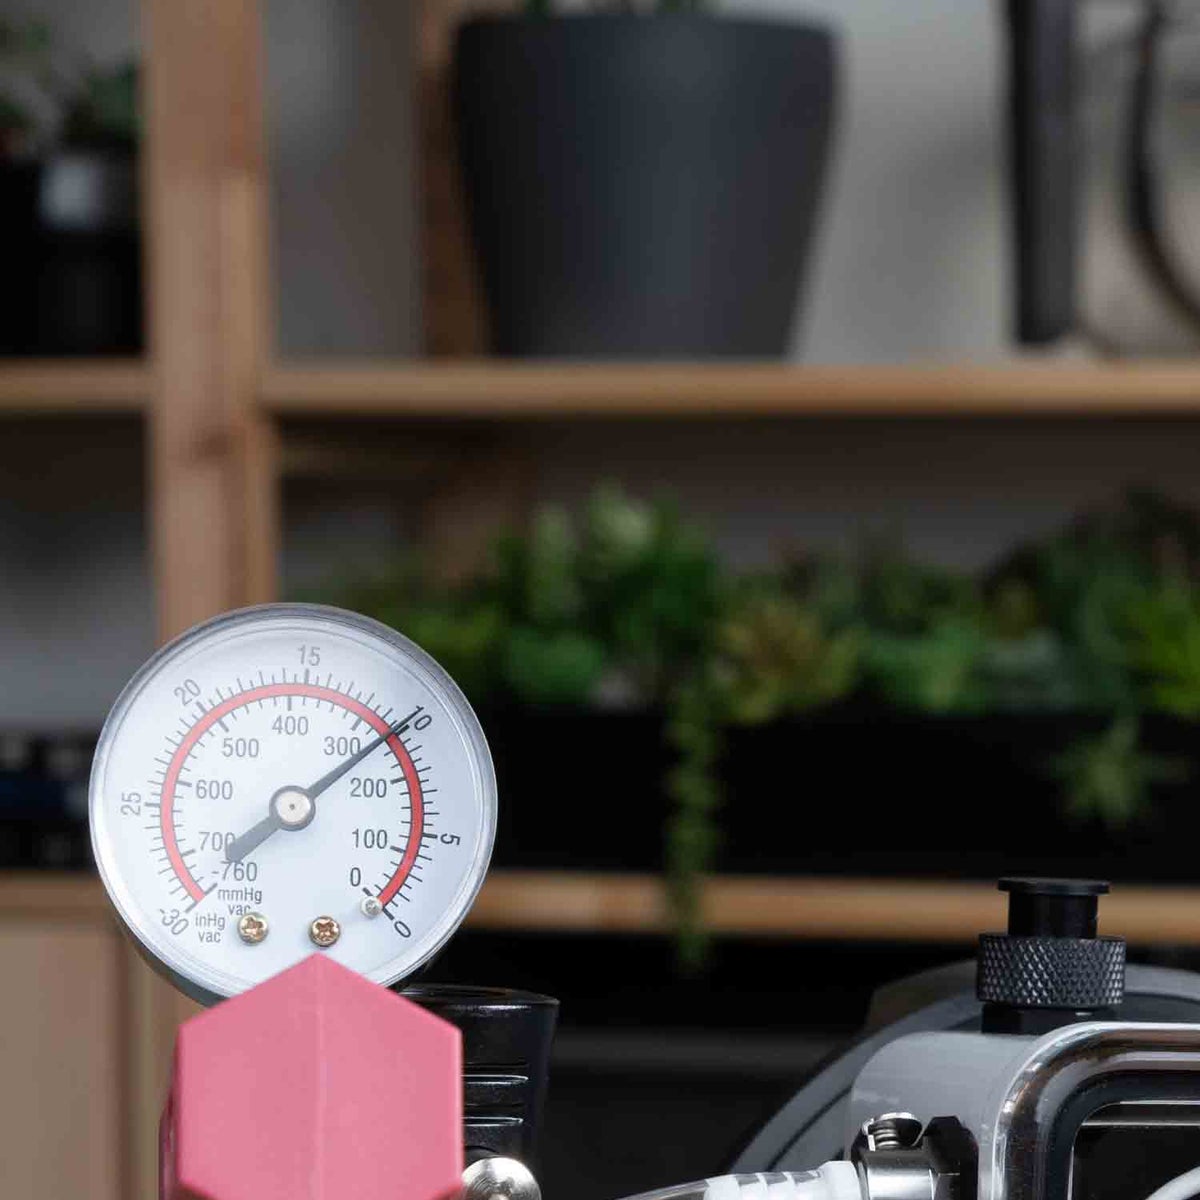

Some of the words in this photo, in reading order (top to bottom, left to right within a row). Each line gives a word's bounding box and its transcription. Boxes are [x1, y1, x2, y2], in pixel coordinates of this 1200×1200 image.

[298, 645, 320, 666] 15
[173, 678, 202, 706] 20
[271, 715, 309, 736] 400
[411, 705, 433, 731] 10
[222, 737, 260, 758] 500
[323, 735, 361, 757] 300
[195, 779, 234, 801] 600
[350, 777, 388, 799] 200
[120, 791, 142, 816] 25
[198, 831, 236, 852] 700
[351, 828, 388, 849] 100
[440, 832, 461, 846] 5
[350, 866, 362, 887] 0
[217, 886, 263, 905] mmHg
[159, 907, 190, 936] -30
[194, 911, 226, 931] inHg
[393, 920, 412, 939] 0
[197, 930, 222, 944] vac
